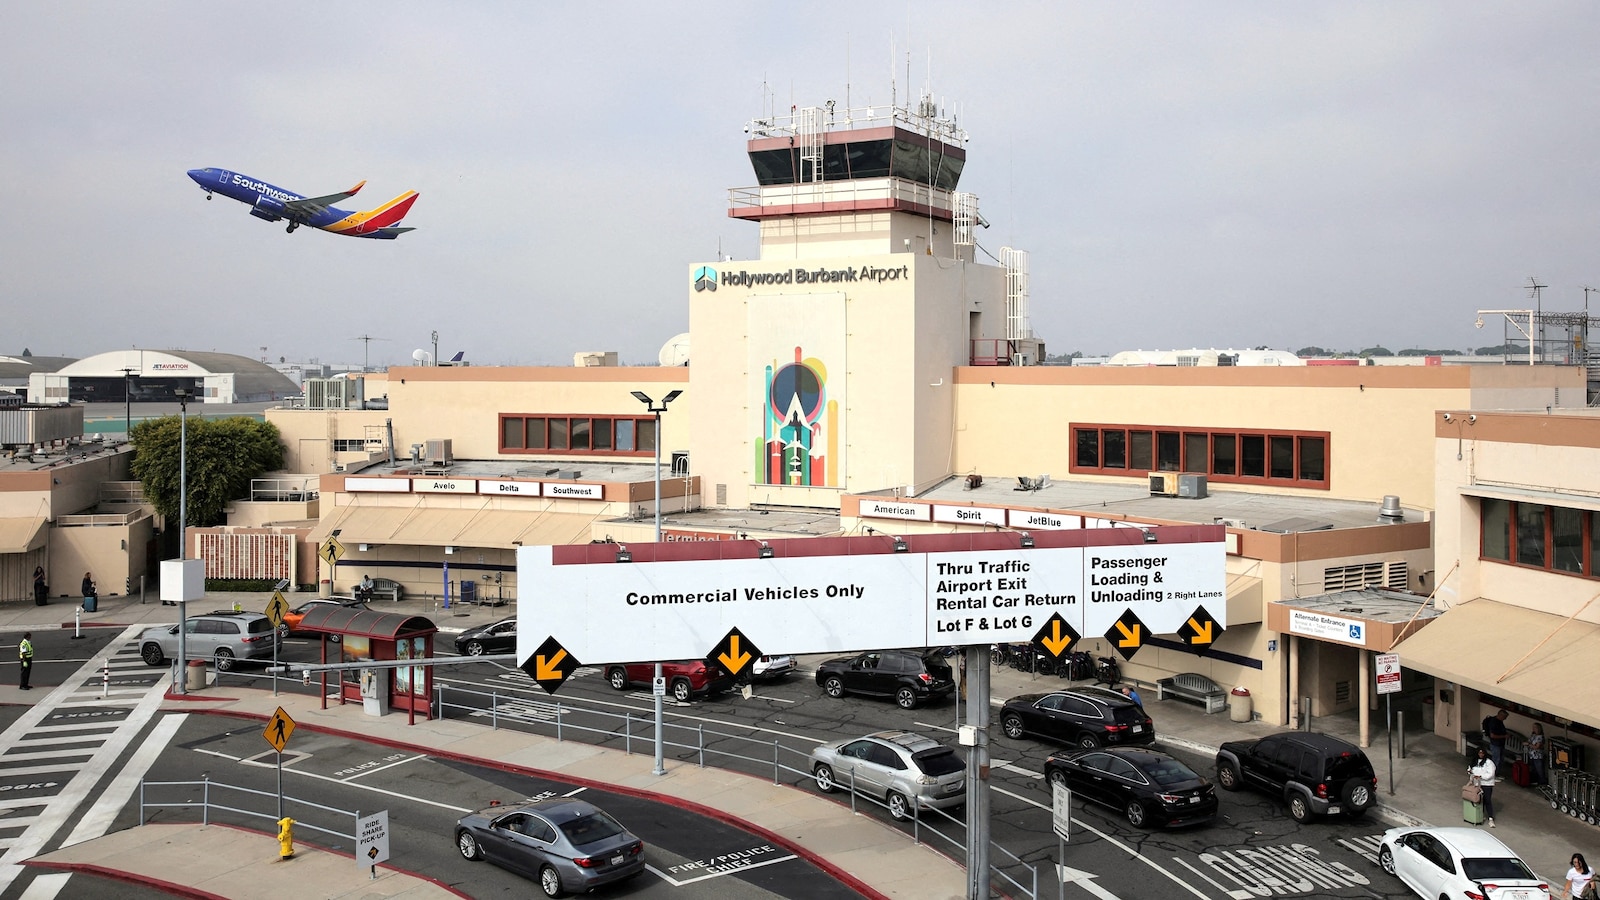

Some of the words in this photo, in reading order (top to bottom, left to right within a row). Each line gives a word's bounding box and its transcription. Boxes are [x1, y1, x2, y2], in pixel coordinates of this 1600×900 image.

[721, 268, 793, 288] Hollywood
[794, 266, 858, 284] Burbank
[859, 264, 909, 284] Airport
[433, 482, 456, 490] Avelo
[499, 484, 519, 492] Delta
[553, 486, 592, 495] Southwest
[873, 504, 916, 516] American
[956, 509, 982, 521] Spirit
[1027, 515, 1062, 527] JetBlue
[936, 562, 973, 576] Thru
[979, 560, 1031, 574] Traffic
[1091, 557, 1168, 570] Passenger
[1091, 572, 1149, 586] Loading
[1153, 571, 1164, 584] &
[936, 580, 993, 595] Airport
[997, 577, 1028, 591] Exit
[626, 588, 738, 606] Commercial
[744, 586, 819, 601] Vehicles
[825, 584, 865, 599] Only
[936, 596, 987, 611] Rental
[992, 595, 1020, 608] Car
[1025, 593, 1076, 606] Return
[1091, 589, 1164, 603] Unloading
[1166, 592, 1173, 600] 2
[1174, 591, 1196, 601] Right
[1198, 590, 1223, 598] Lanes
[937, 619, 961, 633] Lot
[965, 618, 974, 631] F
[978, 617, 989, 630] &
[994, 616, 1017, 630] Lot
[1021, 615, 1032, 628] G
[1295, 613, 1320, 623] Alternate
[1320, 617, 1346, 627] Entrance
[334, 760, 380, 776] POLICE
[0, 782, 45, 791] OOK
[526, 790, 557, 803] LICE
[364, 819, 380, 829] RIDE
[360, 831, 386, 845] PICK-UP
[361, 825, 383, 838] SHARE
[706, 858, 752, 874] CHIEF
